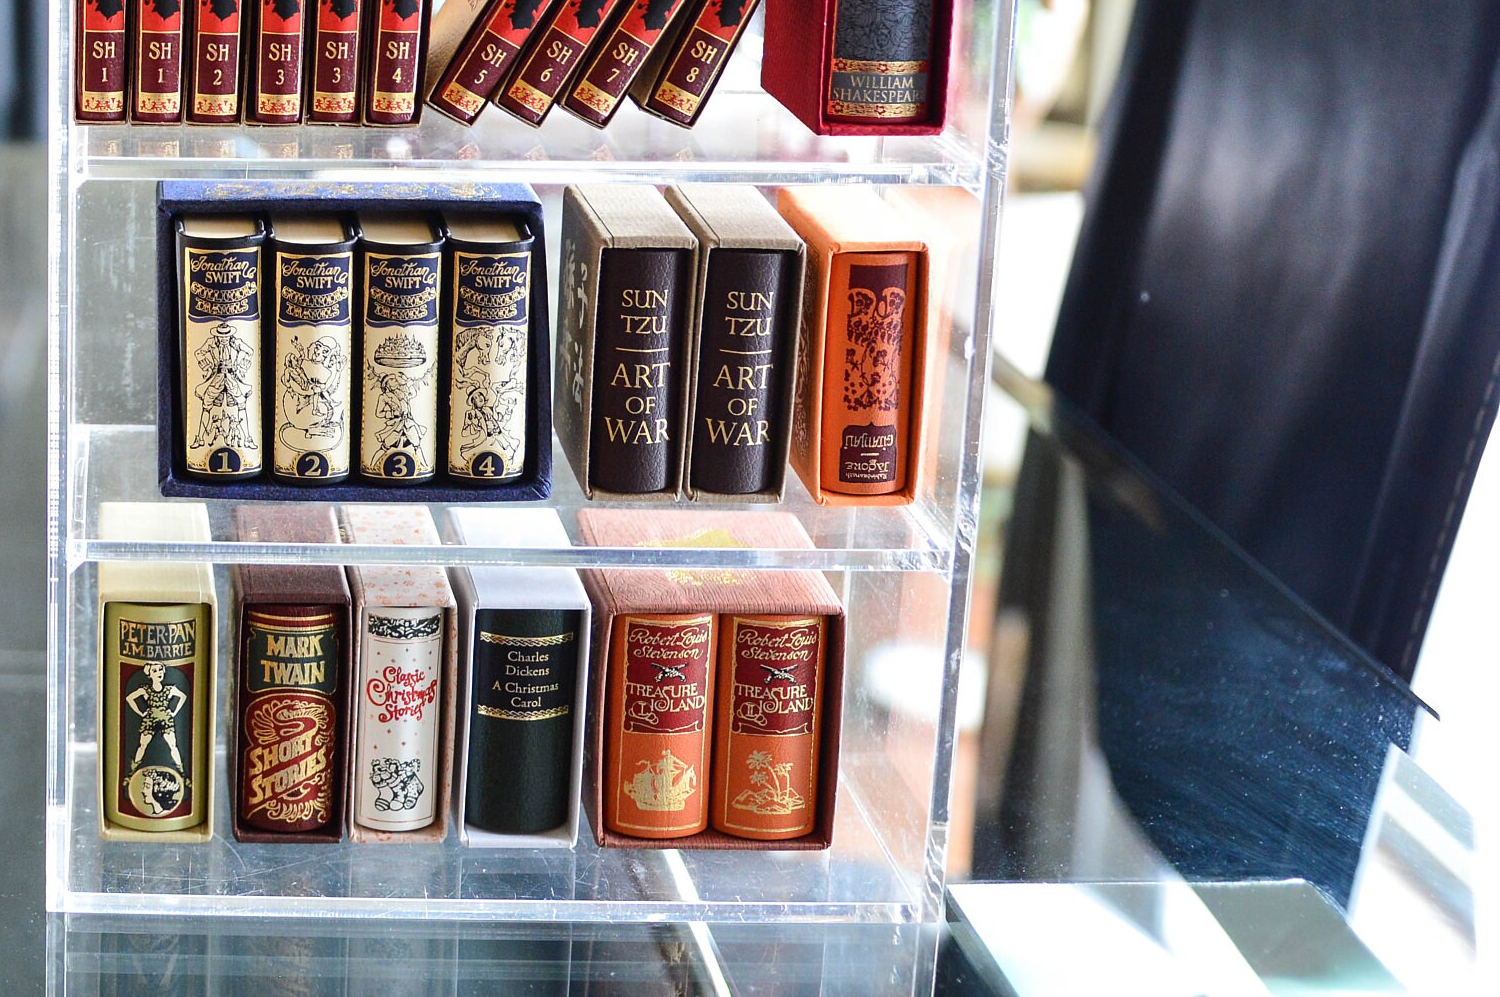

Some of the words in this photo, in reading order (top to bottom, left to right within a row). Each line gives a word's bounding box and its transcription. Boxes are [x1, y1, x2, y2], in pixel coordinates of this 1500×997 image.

[92, 41, 116, 59] SH
[149, 41, 172, 59] SH
[206, 43, 230, 61] SH
[269, 43, 292, 61] SH
[325, 41, 349, 60] SH
[386, 41, 409, 60] SH
[481, 43, 507, 67] SH
[547, 41, 572, 65] SH
[612, 42, 640, 66] SH
[691, 40, 717, 64] SH
[102, 68, 108, 82] 1
[158, 69, 164, 83] 1
[213, 70, 222, 85] 2
[276, 70, 284, 85] 3
[332, 67, 341, 83] 3
[392, 67, 401, 83] 4
[474, 70, 486, 84] 5
[541, 67, 551, 82] 6
[606, 69, 619, 83] 7
[687, 67, 698, 82] 8
[851, 75, 913, 88] WILLIAM
[192, 258, 256, 276] Jonathan
[205, 271, 241, 283] SWIFT
[297, 276, 333, 288] SWIFT
[385, 276, 421, 288] SWIFT
[475, 276, 511, 288] SWIFT
[622, 289, 668, 308] SUN
[621, 316, 667, 334] TZU
[611, 363, 670, 388] ART
[625, 397, 656, 414] OF
[605, 417, 670, 443] WAR
[218, 453, 232, 472] 1
[304, 456, 322, 475] 2
[392, 457, 408, 476] 3
[479, 457, 495, 476] 4
[267, 634, 323, 656] MARK
[629, 630, 677, 645] Robert
[681, 630, 708, 648] Louis
[738, 630, 785, 645] Robert
[787, 630, 817, 649] Louis
[507, 651, 549, 662] Charles
[633, 645, 704, 659] Stevenson
[741, 646, 813, 662] Stevenson
[260, 661, 324, 684] TWAIN
[383, 666, 426, 687] Classic
[505, 665, 549, 676] Dickens
[366, 677, 437, 708] Christmas
[492, 682, 501, 691] A
[505, 682, 559, 694] Christmas
[630, 683, 698, 698] TREASURE
[510, 698, 541, 708] Carol
[378, 703, 423, 722] Stories
[250, 732, 315, 773] SHORT
[250, 747, 327, 803] STORIES
